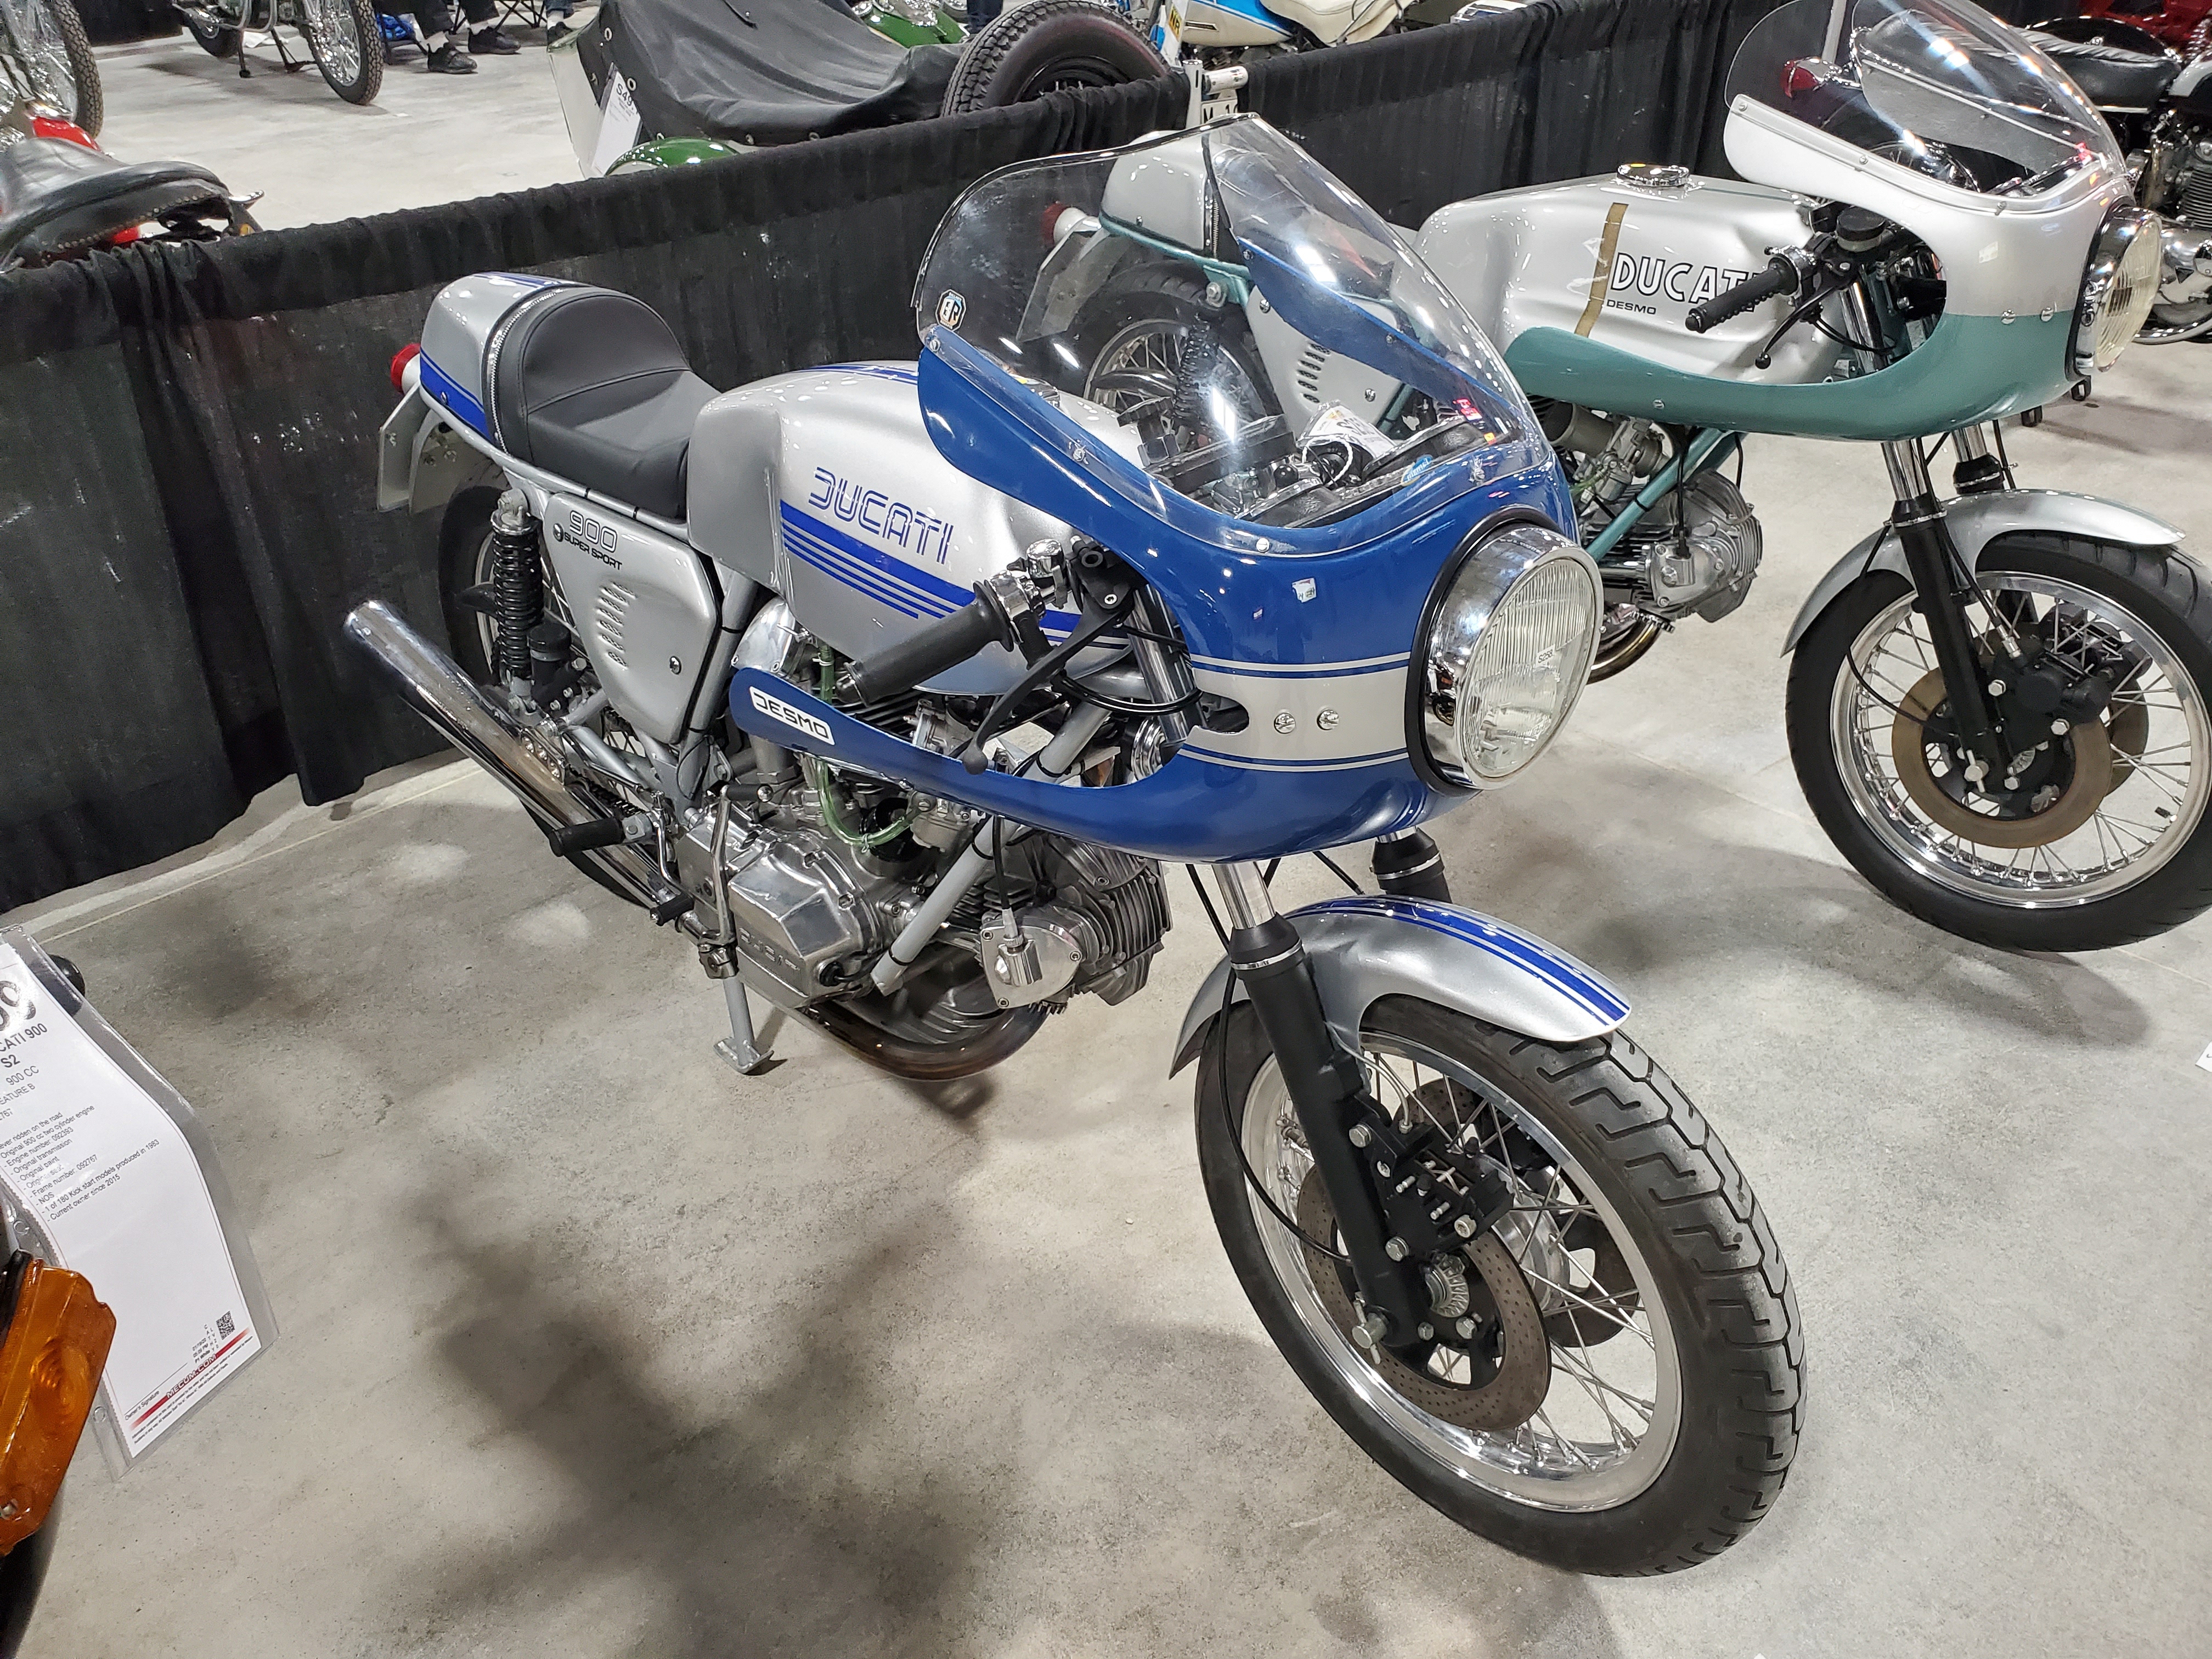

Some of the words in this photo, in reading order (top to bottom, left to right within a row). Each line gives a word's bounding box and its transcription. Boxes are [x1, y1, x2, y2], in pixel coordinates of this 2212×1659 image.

[1611, 252, 1761, 312] DUCAT
[1606, 299, 1657, 315] DESMO
[570, 510, 618, 553] 900
[809, 467, 953, 565] DUCATI
[565, 532, 590, 554] SUPER
[591, 548, 622, 570] SPORT
[1538, 649, 1553, 663] S258
[753, 692, 829, 739] DESMO
[25, 1023, 48, 1039] 900
[1, 1054, 21, 1068] S2
[6, 1073, 25, 1085] 900
[24, 1065, 39, 1077] CC
[1, 1143, 25, 1159] Original
[23, 1136, 36, 1146] 900
[43, 1128, 54, 1136] two
[54, 1115, 76, 1131] cylinder
[75, 1105, 95, 1119] engine
[38, 1119, 50, 1127] the
[49, 1111, 63, 1122] road
[6, 1153, 29, 1166] Engine
[52, 1126, 74, 1141] 092393
[13, 1158, 38, 1173] Original
[36, 1138, 73, 1161] transmission
[19, 1165, 44, 1181] Original
[44, 1156, 60, 1168] paint
[32, 1182, 53, 1197] Frame
[76, 1154, 98, 1171] 092767
[57, 1195, 69, 1204] 180
[69, 1187, 83, 1197] Kick
[82, 1179, 96, 1190] start
[95, 1166, 116, 1182] models
[115, 1150, 140, 1172] produced
[145, 1139, 160, 1150] 1983
[38, 1192, 55, 1204] NOS
[50, 1204, 74, 1220] Current
[73, 1194, 90, 1206] owner
[91, 1184, 106, 1195] since
[105, 1173, 121, 1187] 2015
[166, 1353, 217, 1398] MECUM.COM
[125, 1407, 142, 1420] Owner's
[141, 1390, 160, 1407] Signature
